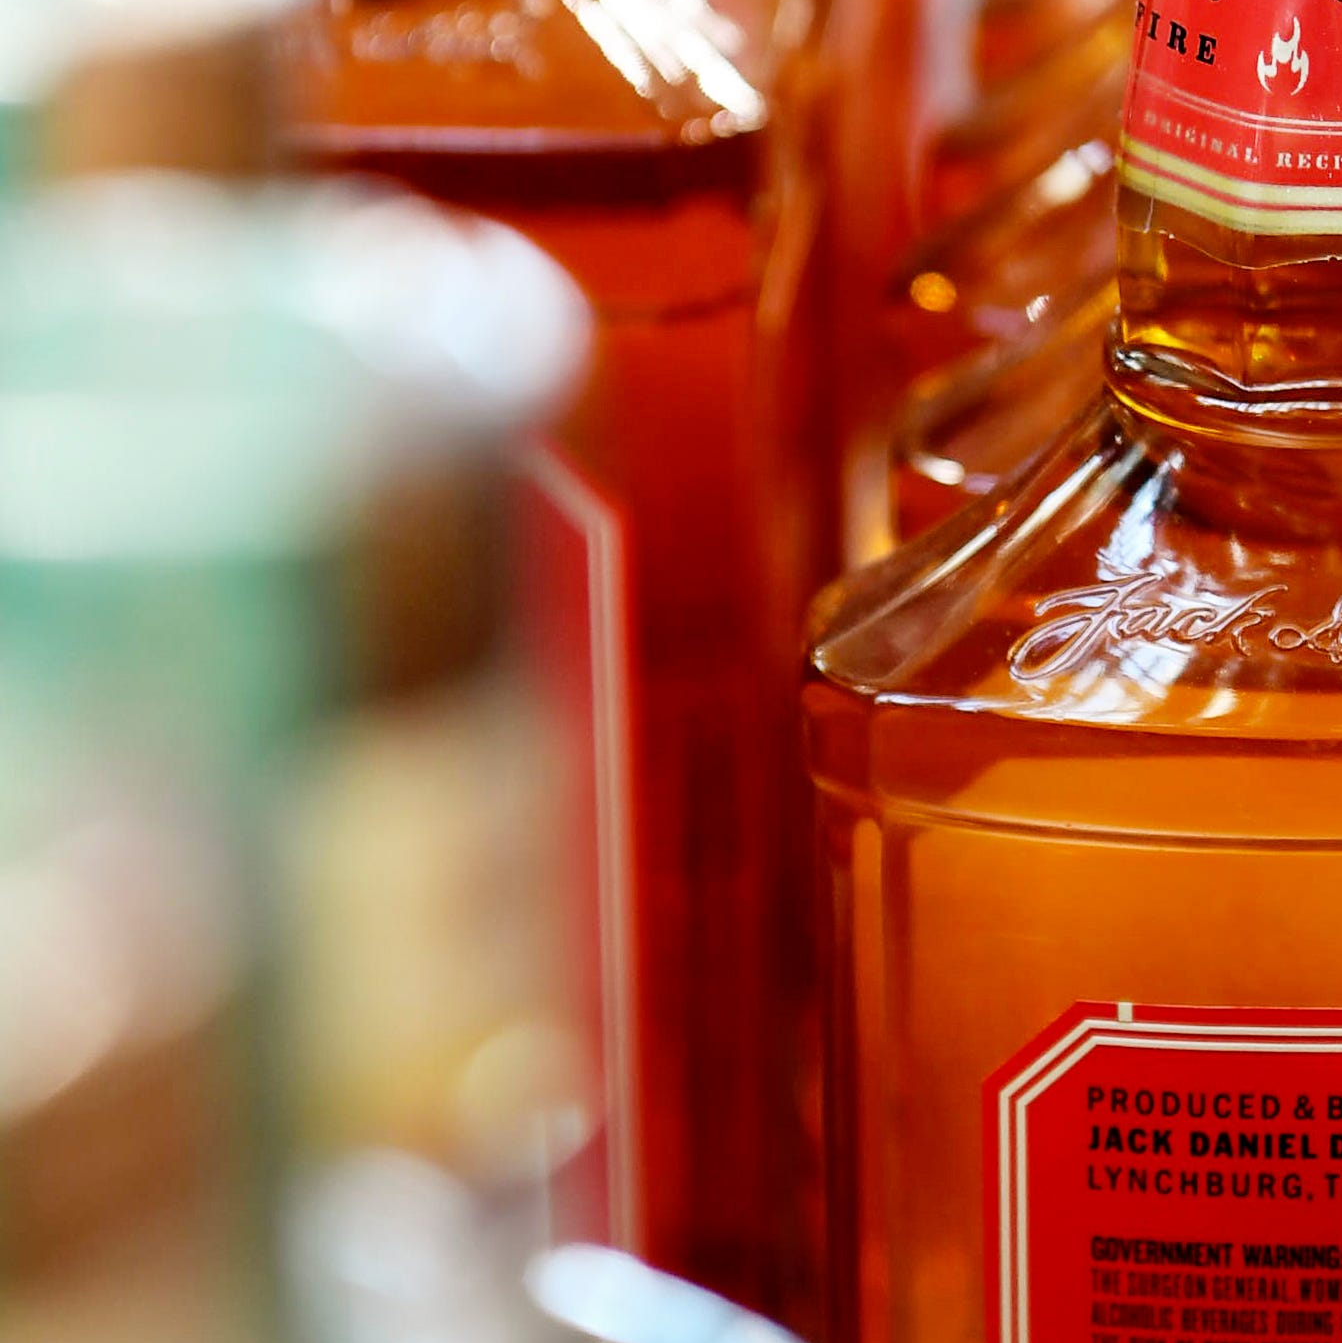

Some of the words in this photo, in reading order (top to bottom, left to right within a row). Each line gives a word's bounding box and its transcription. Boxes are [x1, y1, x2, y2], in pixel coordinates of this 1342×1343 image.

[1143, 108, 1259, 165] ORIGINAL
[1007, 573, 1288, 681] Jack
[1087, 1086, 1281, 1120] PRODUCED
[1293, 1091, 1315, 1121] &
[1088, 1127, 1173, 1156] JACK
[1189, 1130, 1317, 1159] DANIEL
[1087, 1166, 1314, 1201] LYNCHBURG,
[1091, 1235, 1233, 1267] GOVERNMENT
[1091, 1268, 1120, 1295] THE
[1127, 1271, 1206, 1299] SURGEON
[1181, 1307, 1268, 1335] BEVERAGES
